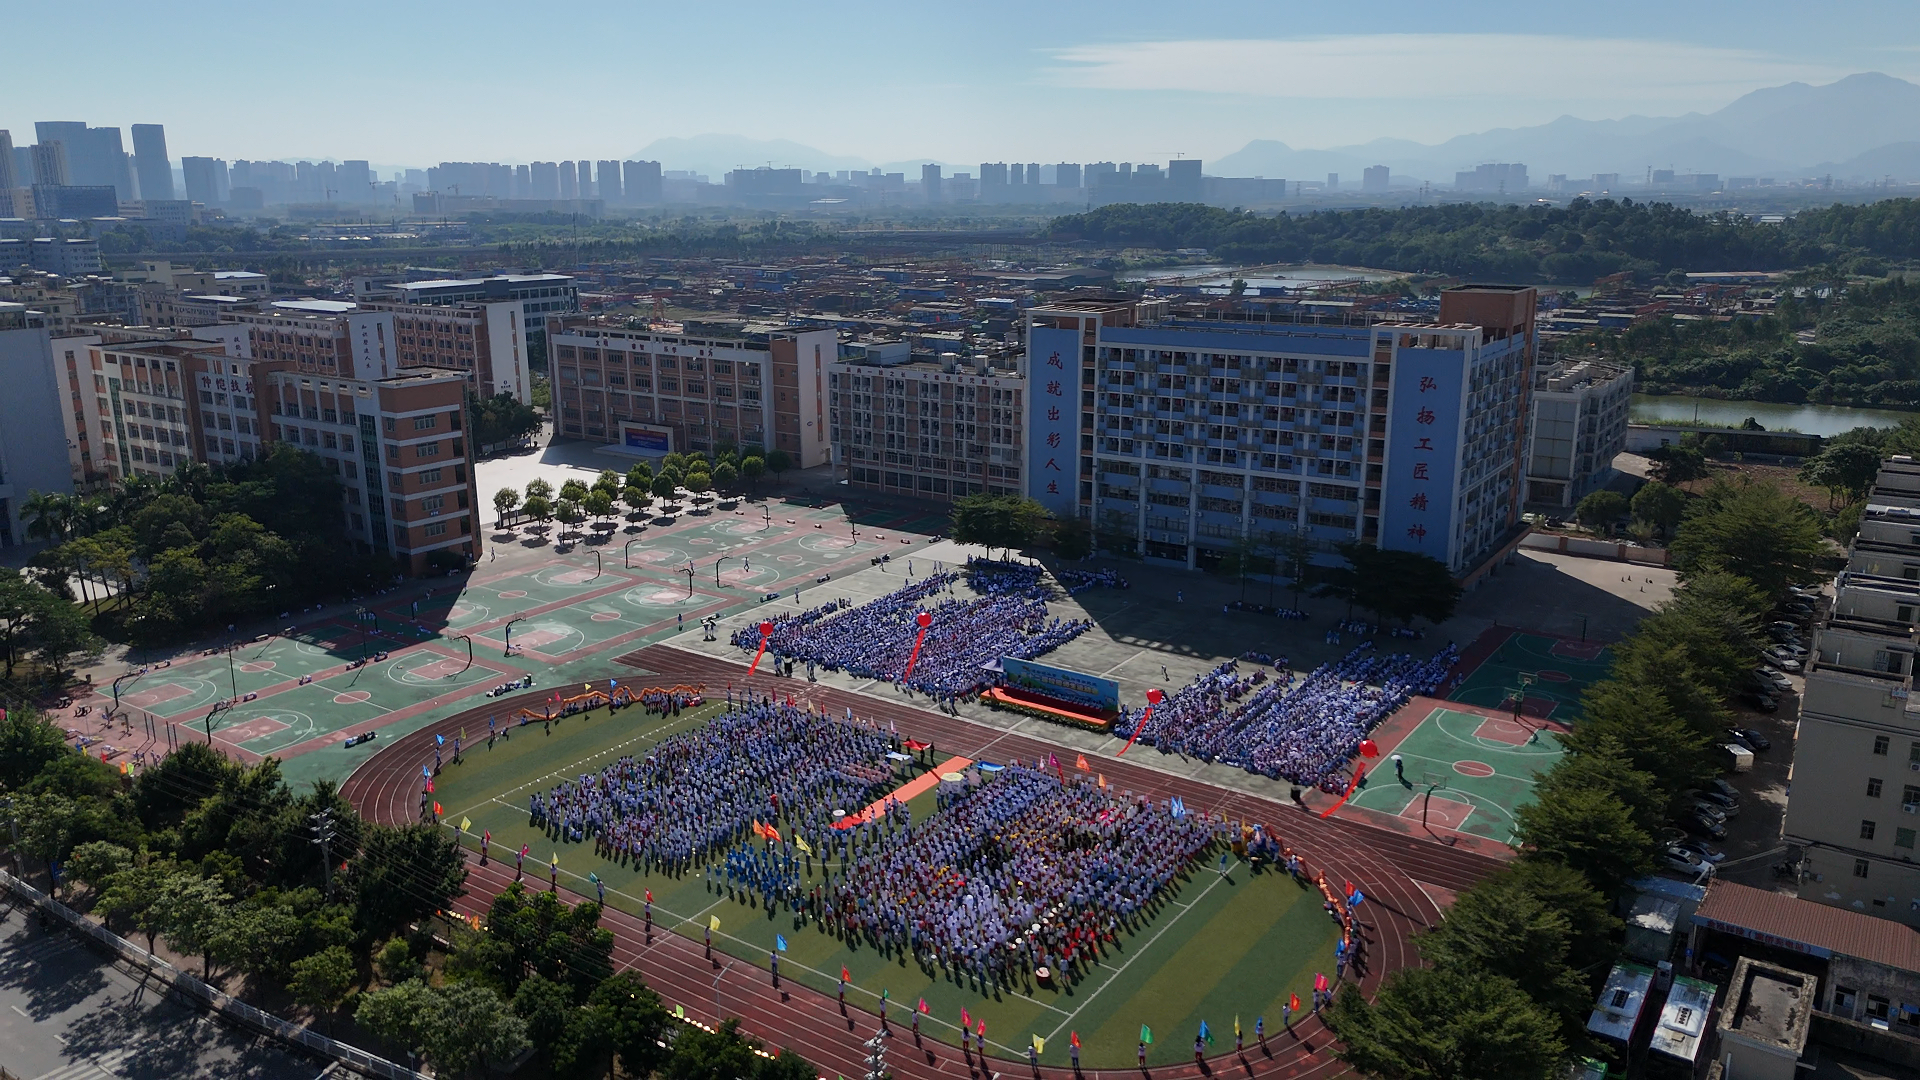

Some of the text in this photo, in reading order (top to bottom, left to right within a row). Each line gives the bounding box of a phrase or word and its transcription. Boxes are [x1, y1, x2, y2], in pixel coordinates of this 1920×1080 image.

[201, 376, 255, 394] 仲恺技校
[1045, 351, 1063, 494] 成就出彩人生
[1407, 376, 1437, 544] 弘扬工匠精神
